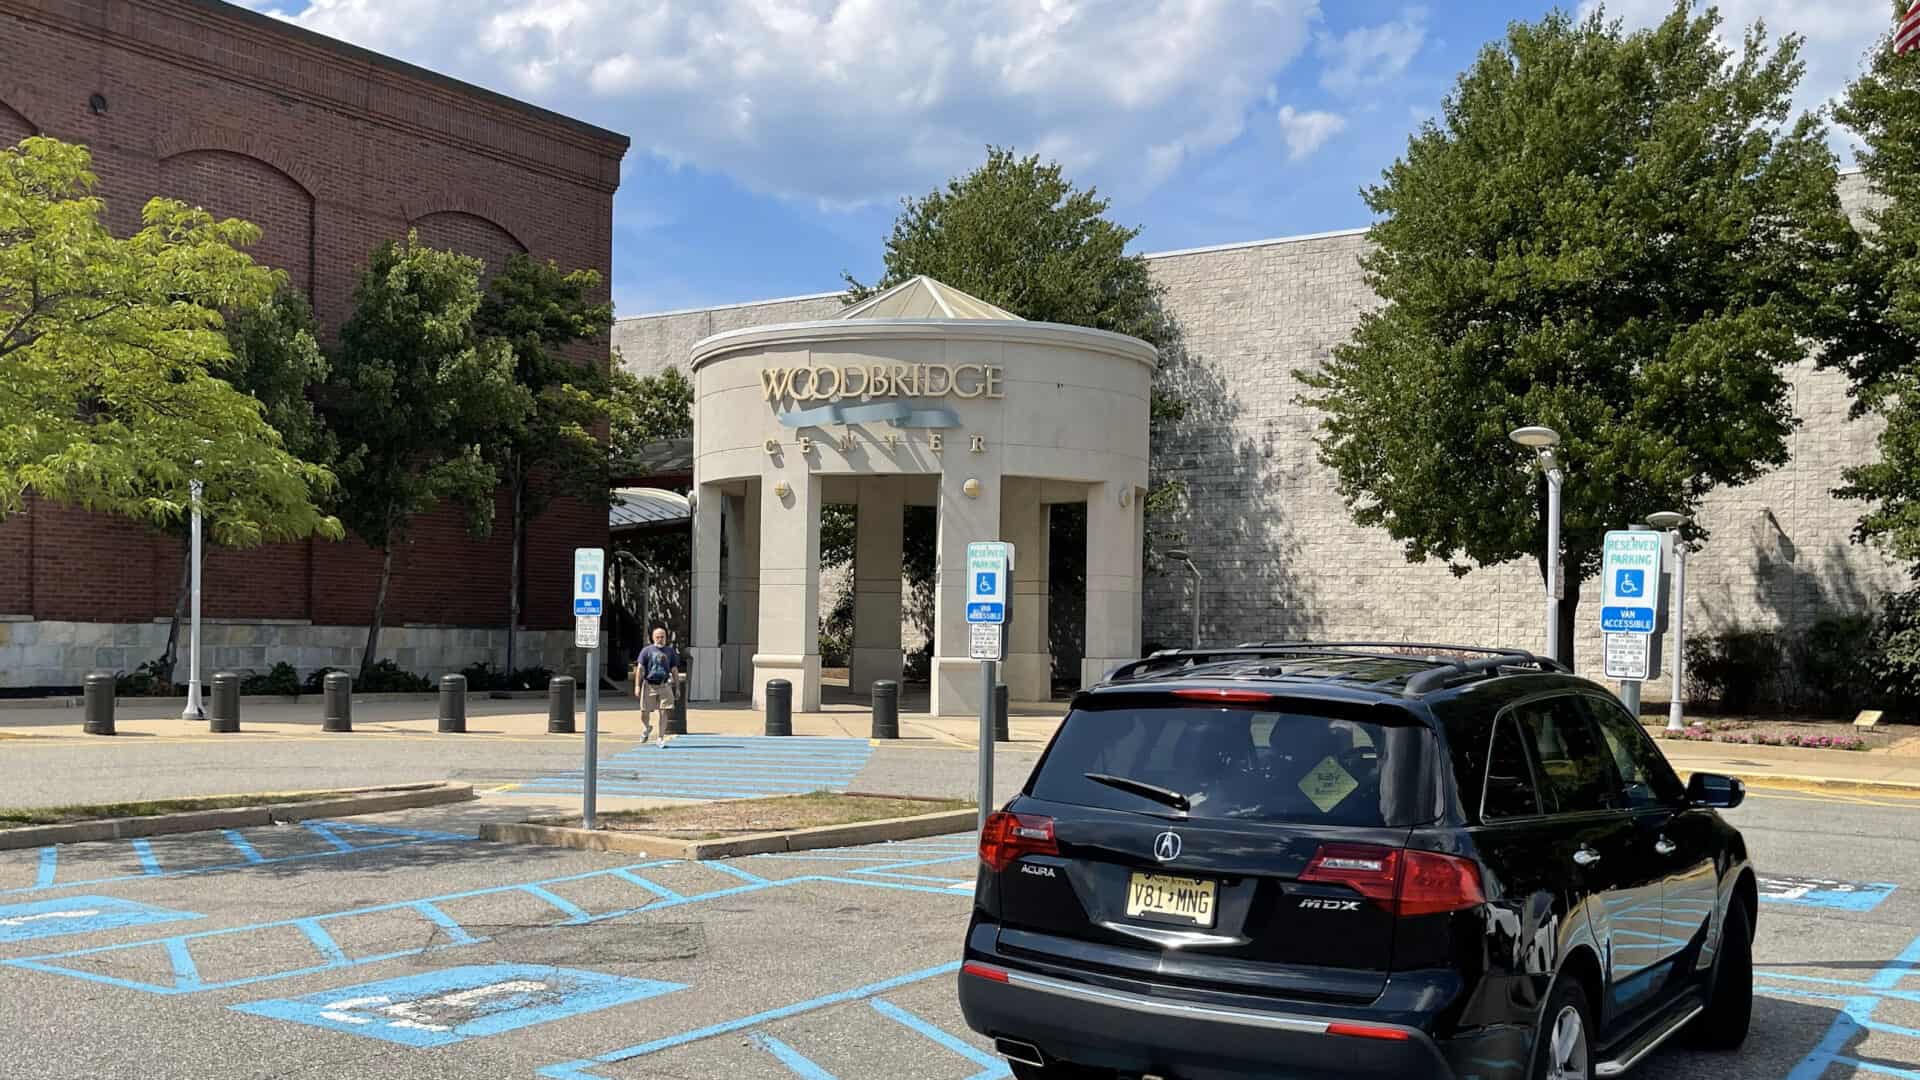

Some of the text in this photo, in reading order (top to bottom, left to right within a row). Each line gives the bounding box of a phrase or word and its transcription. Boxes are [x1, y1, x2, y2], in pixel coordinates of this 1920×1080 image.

[760, 363, 1005, 400] WOODBRIDGE
[763, 432, 985, 455] CENTER
[1607, 540, 1657, 551] RESERVED
[1610, 554, 1652, 565] PARKING
[1620, 610, 1635, 619] VAN
[1603, 619, 1651, 629] ACCESSIBLE
[1021, 863, 1056, 878] ACURA
[1298, 898, 1361, 911] MDX
